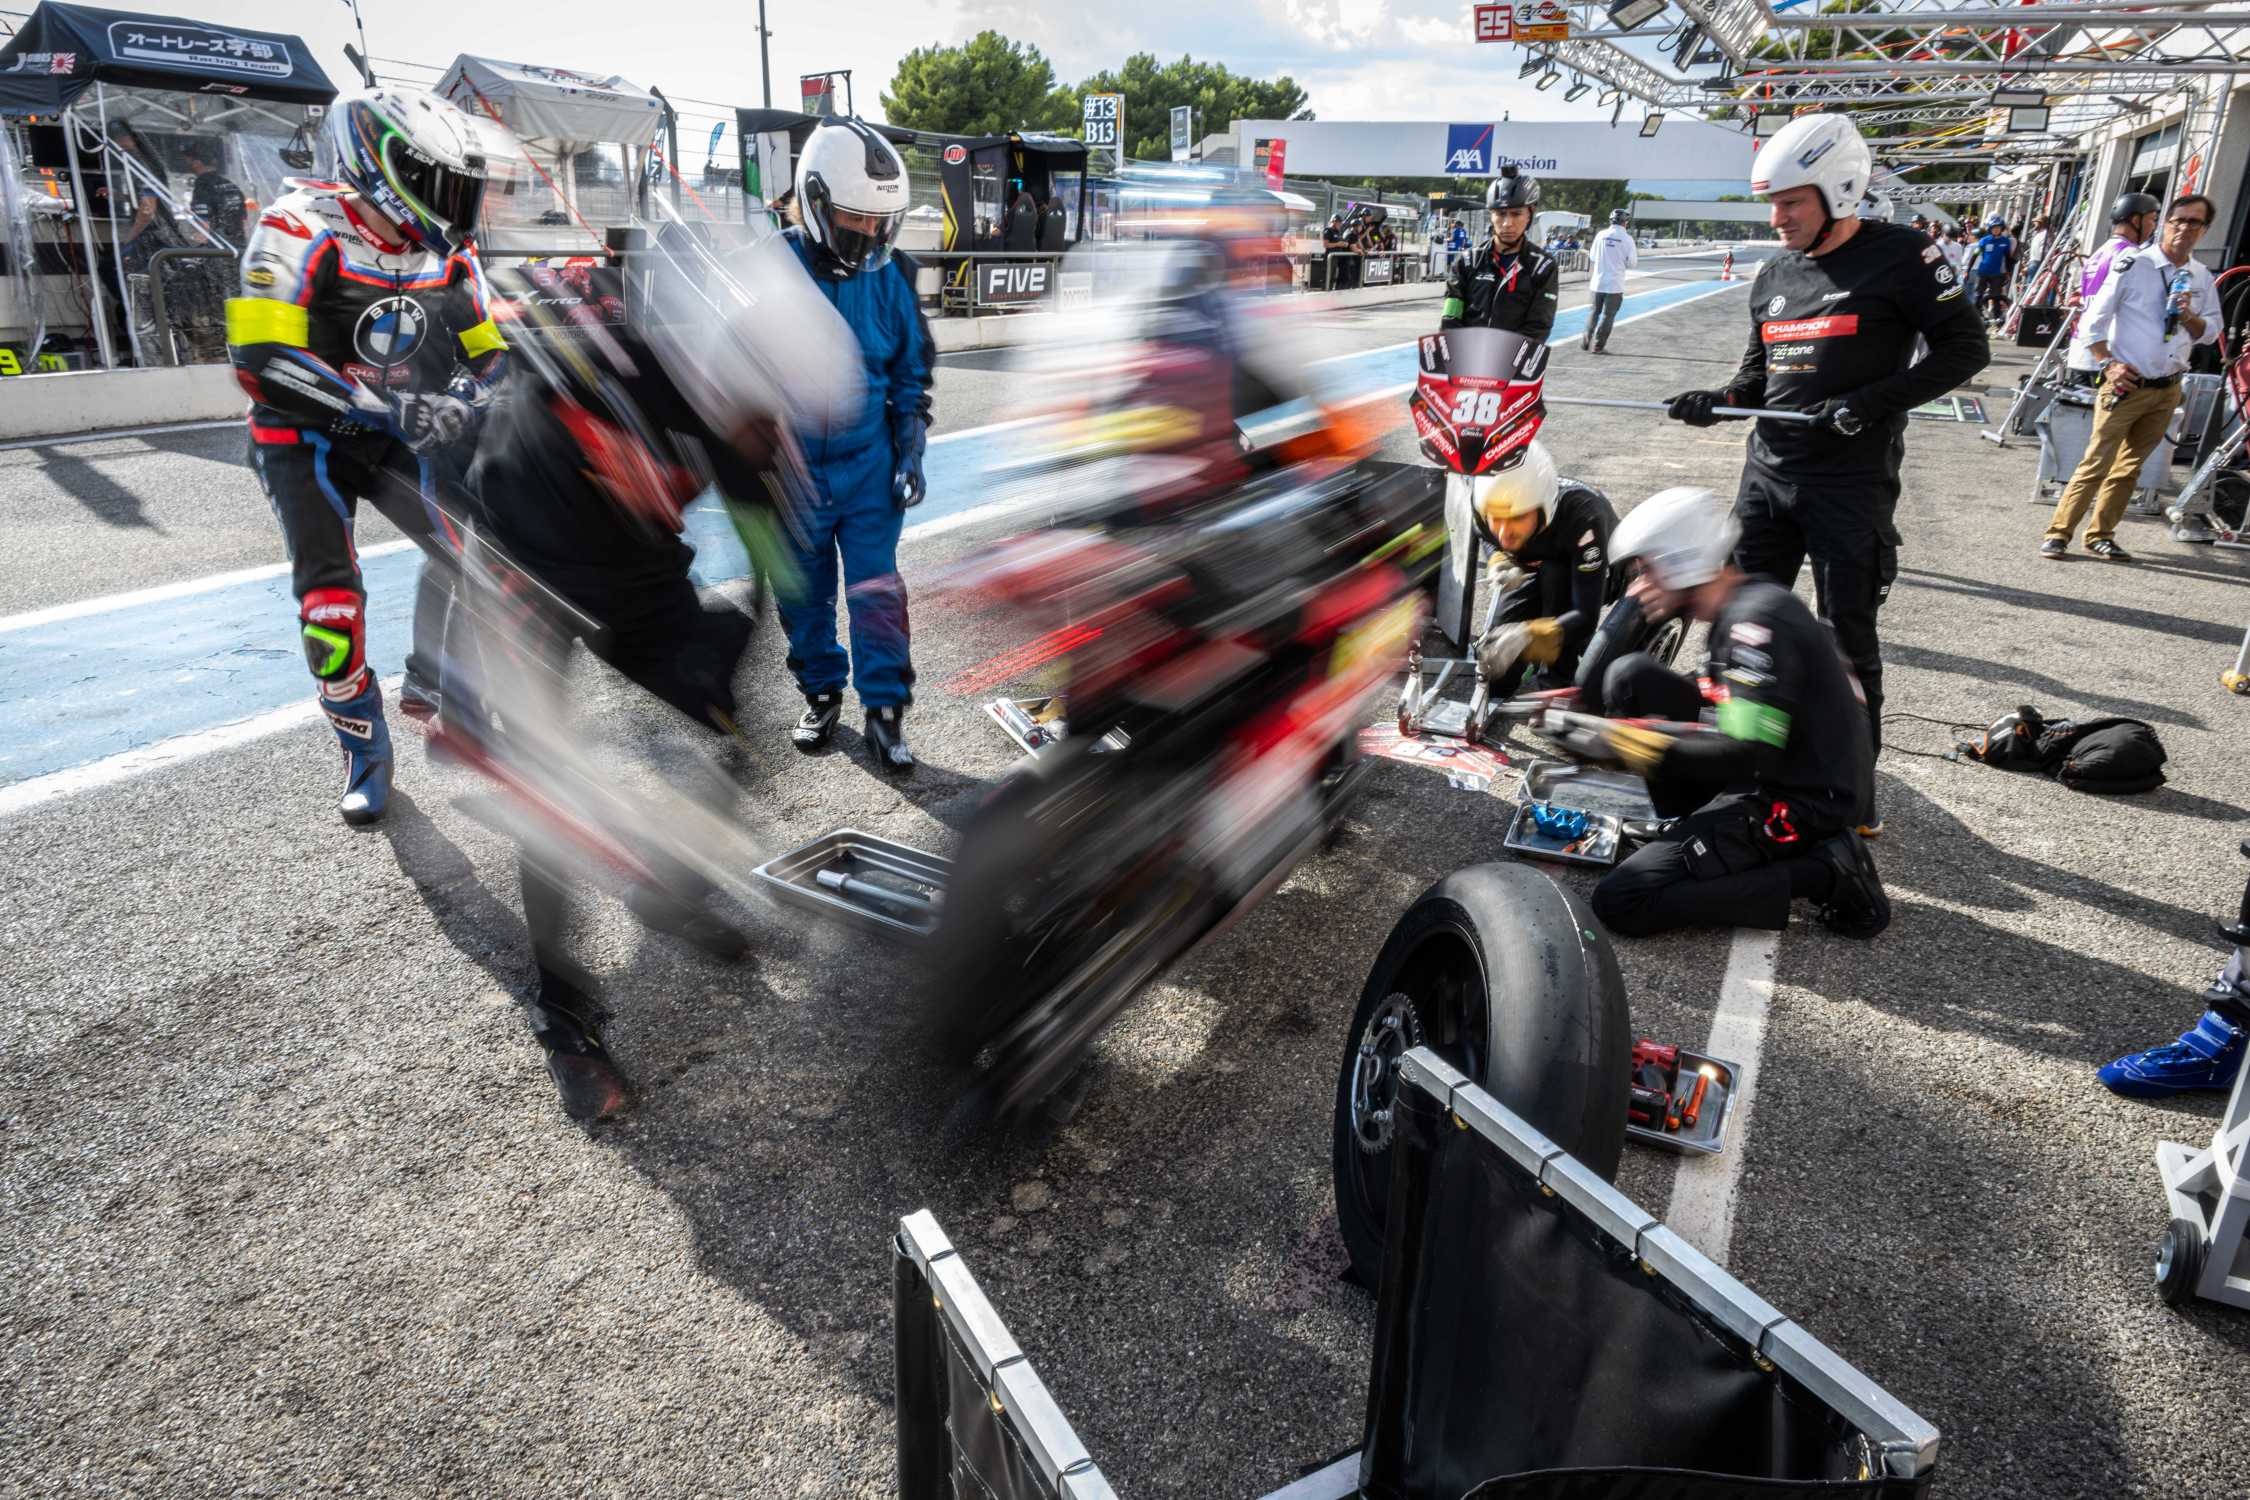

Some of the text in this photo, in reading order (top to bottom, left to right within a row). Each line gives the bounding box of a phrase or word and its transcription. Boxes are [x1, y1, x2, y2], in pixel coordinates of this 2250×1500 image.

[1479, 9, 1510, 37] 25
[1085, 96, 1116, 118] #13
[1085, 121, 1115, 143] B13
[1445, 149, 1484, 170] AXA
[1497, 155, 1557, 171] Passion
[370, 301, 423, 321] BMW
[1767, 318, 1832, 335] CHAMPION
[1451, 390, 1502, 425] 38
[1484, 421, 1535, 460] CHAMPION
